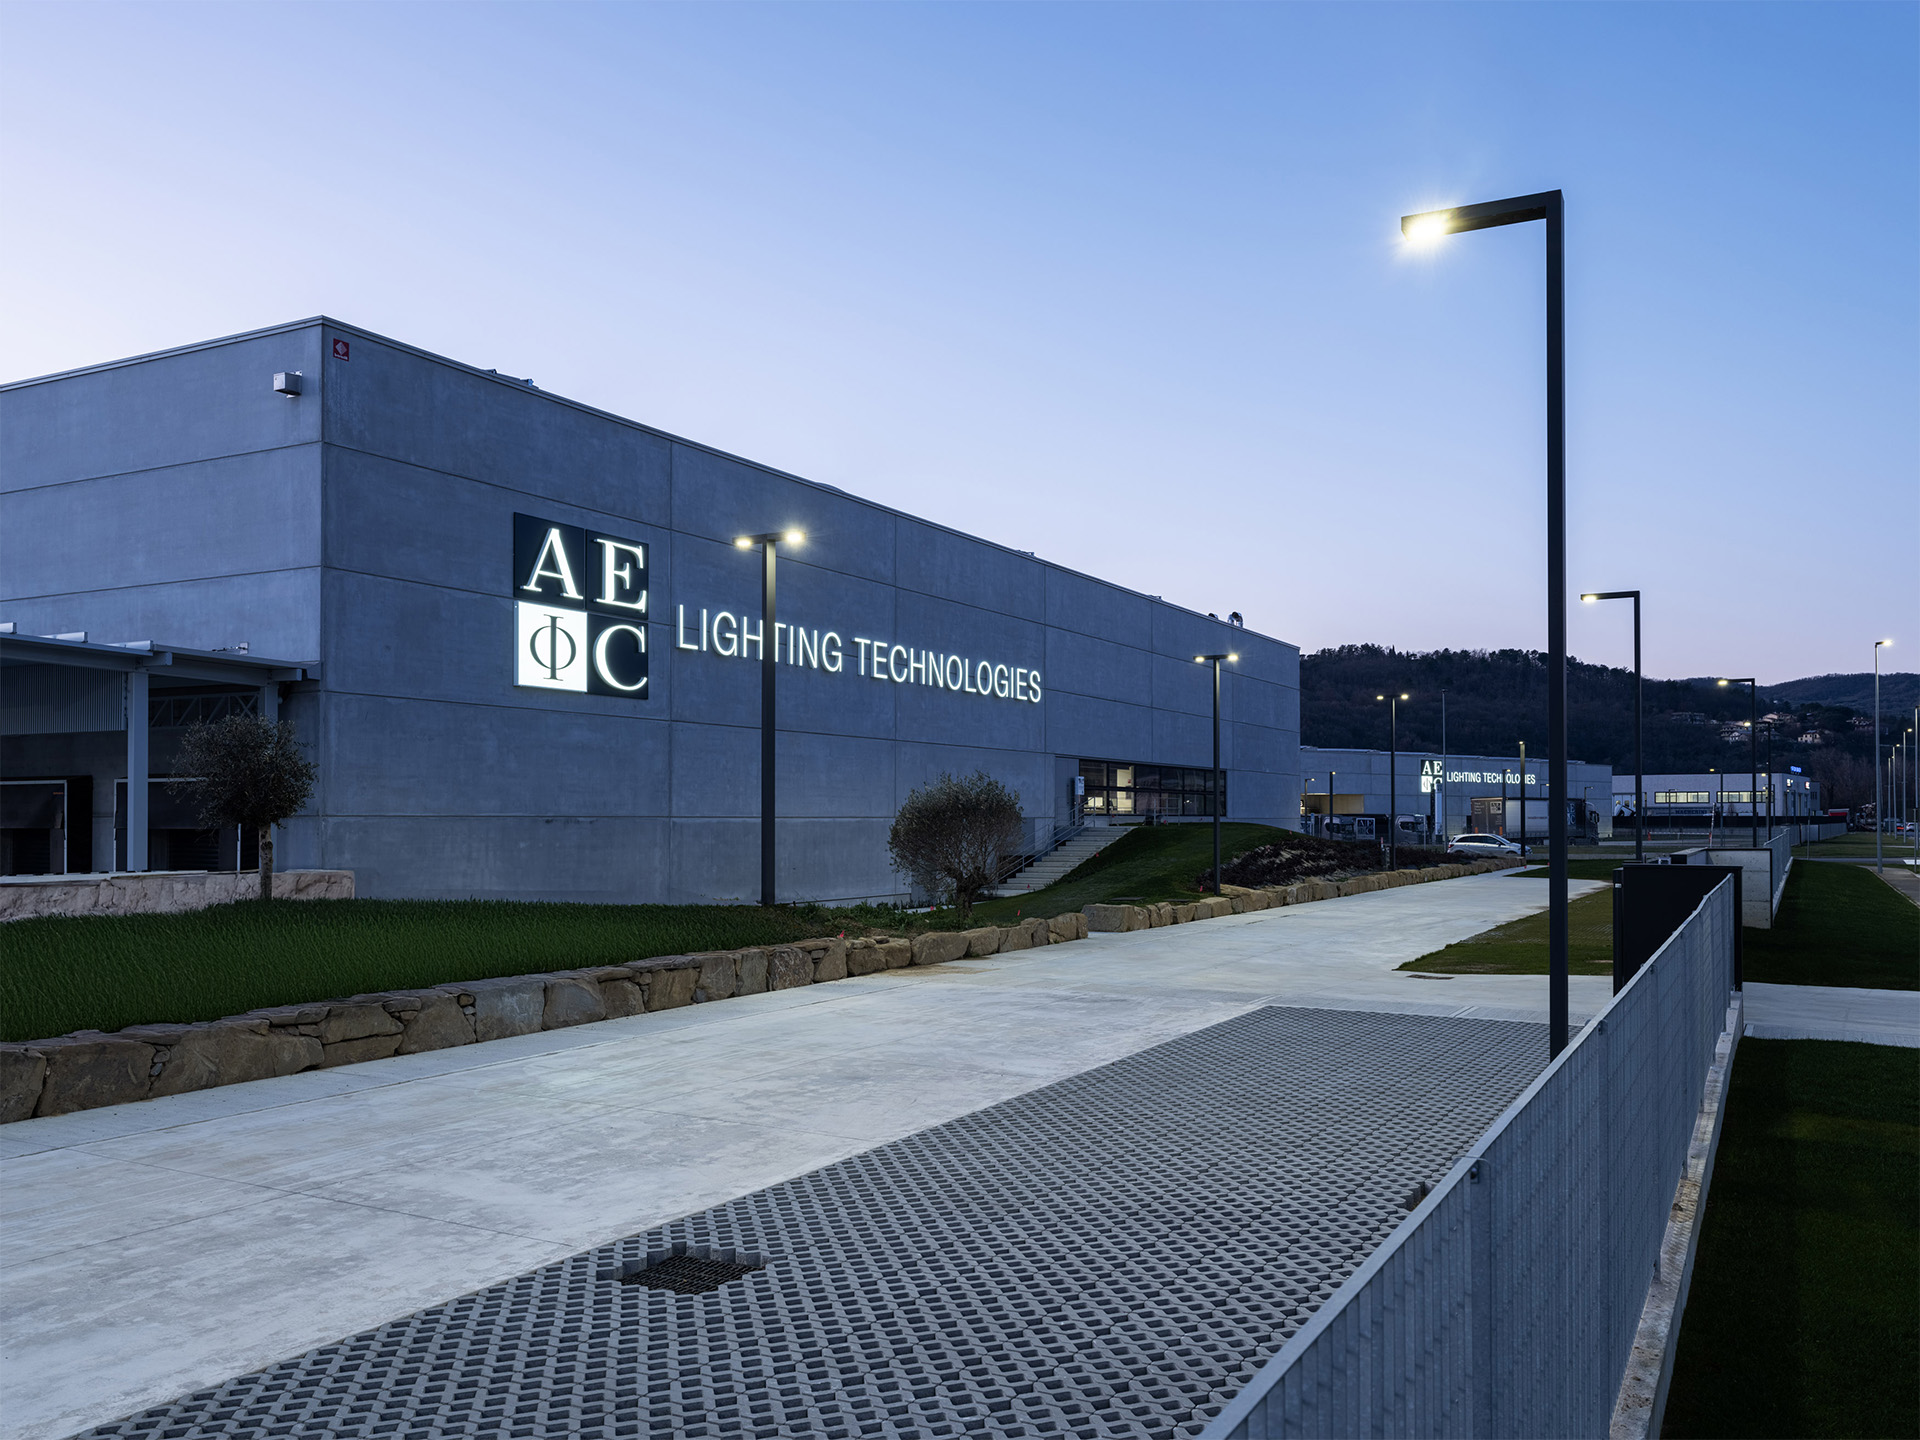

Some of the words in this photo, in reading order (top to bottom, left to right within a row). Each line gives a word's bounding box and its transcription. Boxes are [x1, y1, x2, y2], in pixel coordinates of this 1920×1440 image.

[676, 604, 842, 672] LIGHTING
[852, 637, 1042, 703] TECHNOLOGIES
[1446, 771, 1481, 784] LIGHTING
[1482, 772, 1536, 785] TECHOLOIES
